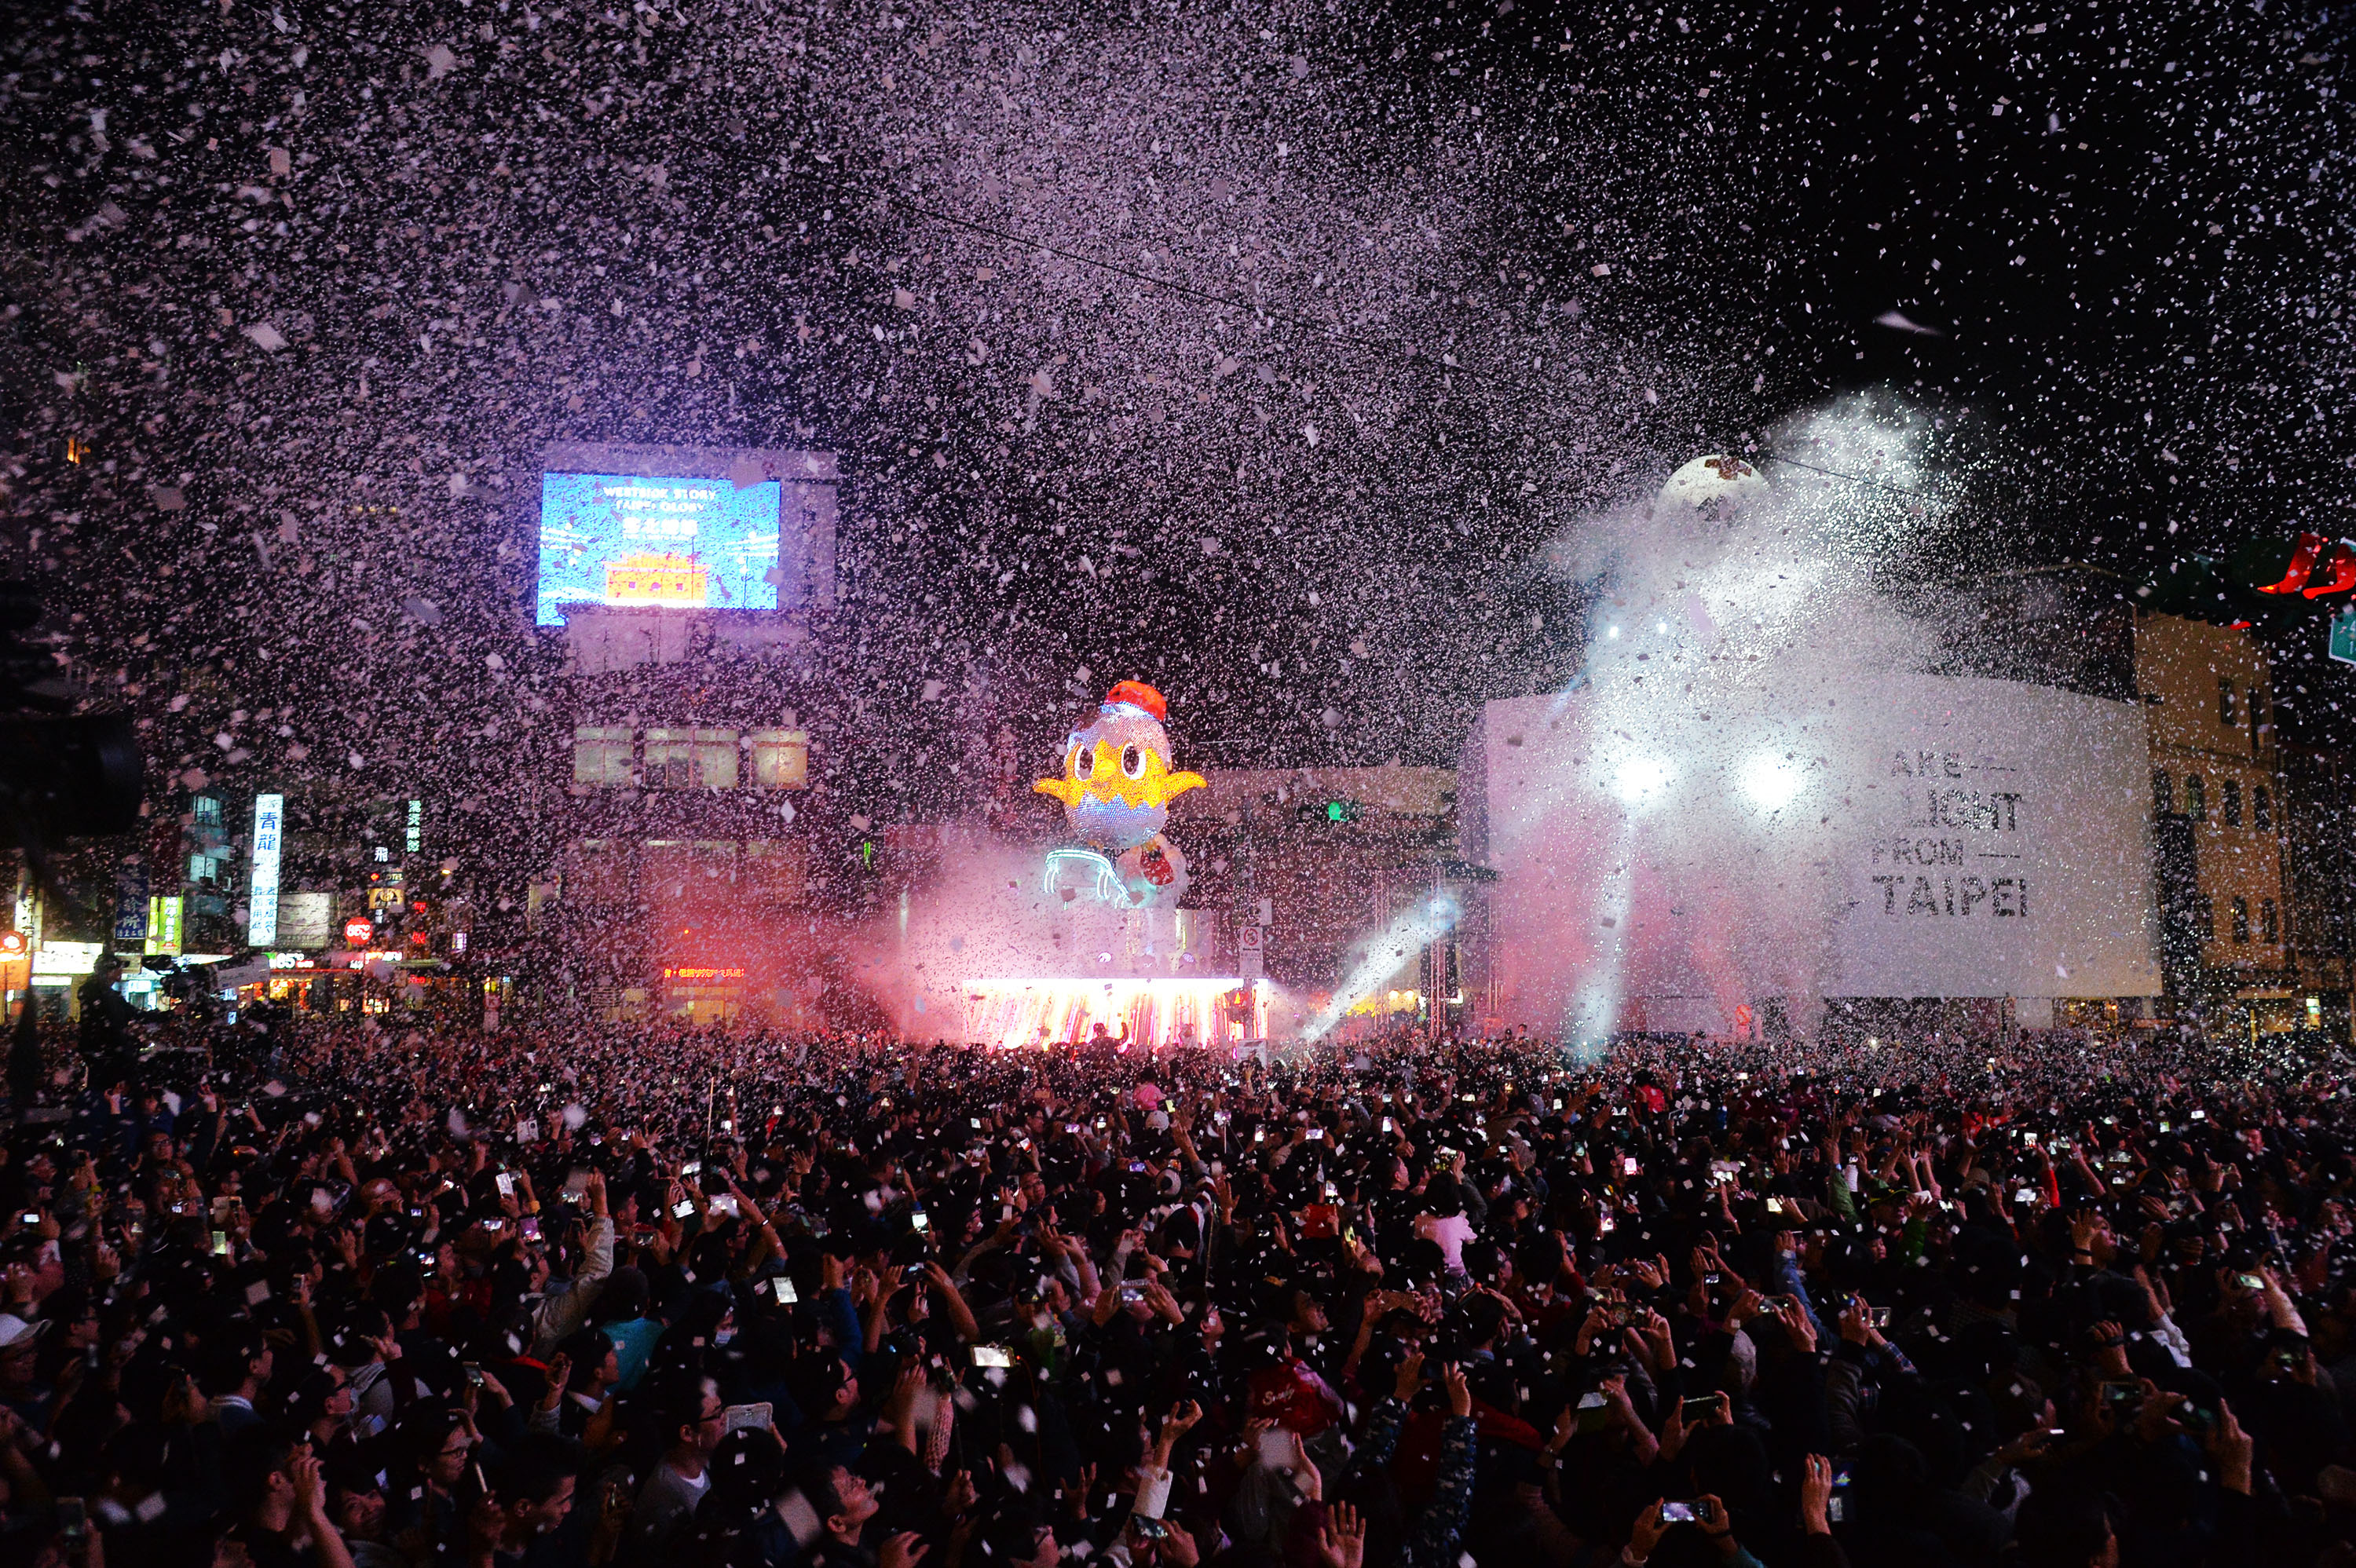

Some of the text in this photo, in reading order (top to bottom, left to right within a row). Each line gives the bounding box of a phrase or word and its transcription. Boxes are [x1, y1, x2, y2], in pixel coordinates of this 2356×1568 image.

[673, 488, 717, 500] STORY
[659, 501, 706, 513] GLORY
[258, 812, 278, 851] 青龍
[374, 846, 389, 862] 飛
[1871, 837, 1963, 865] FROM
[1872, 875, 2027, 917] TAIPEI
